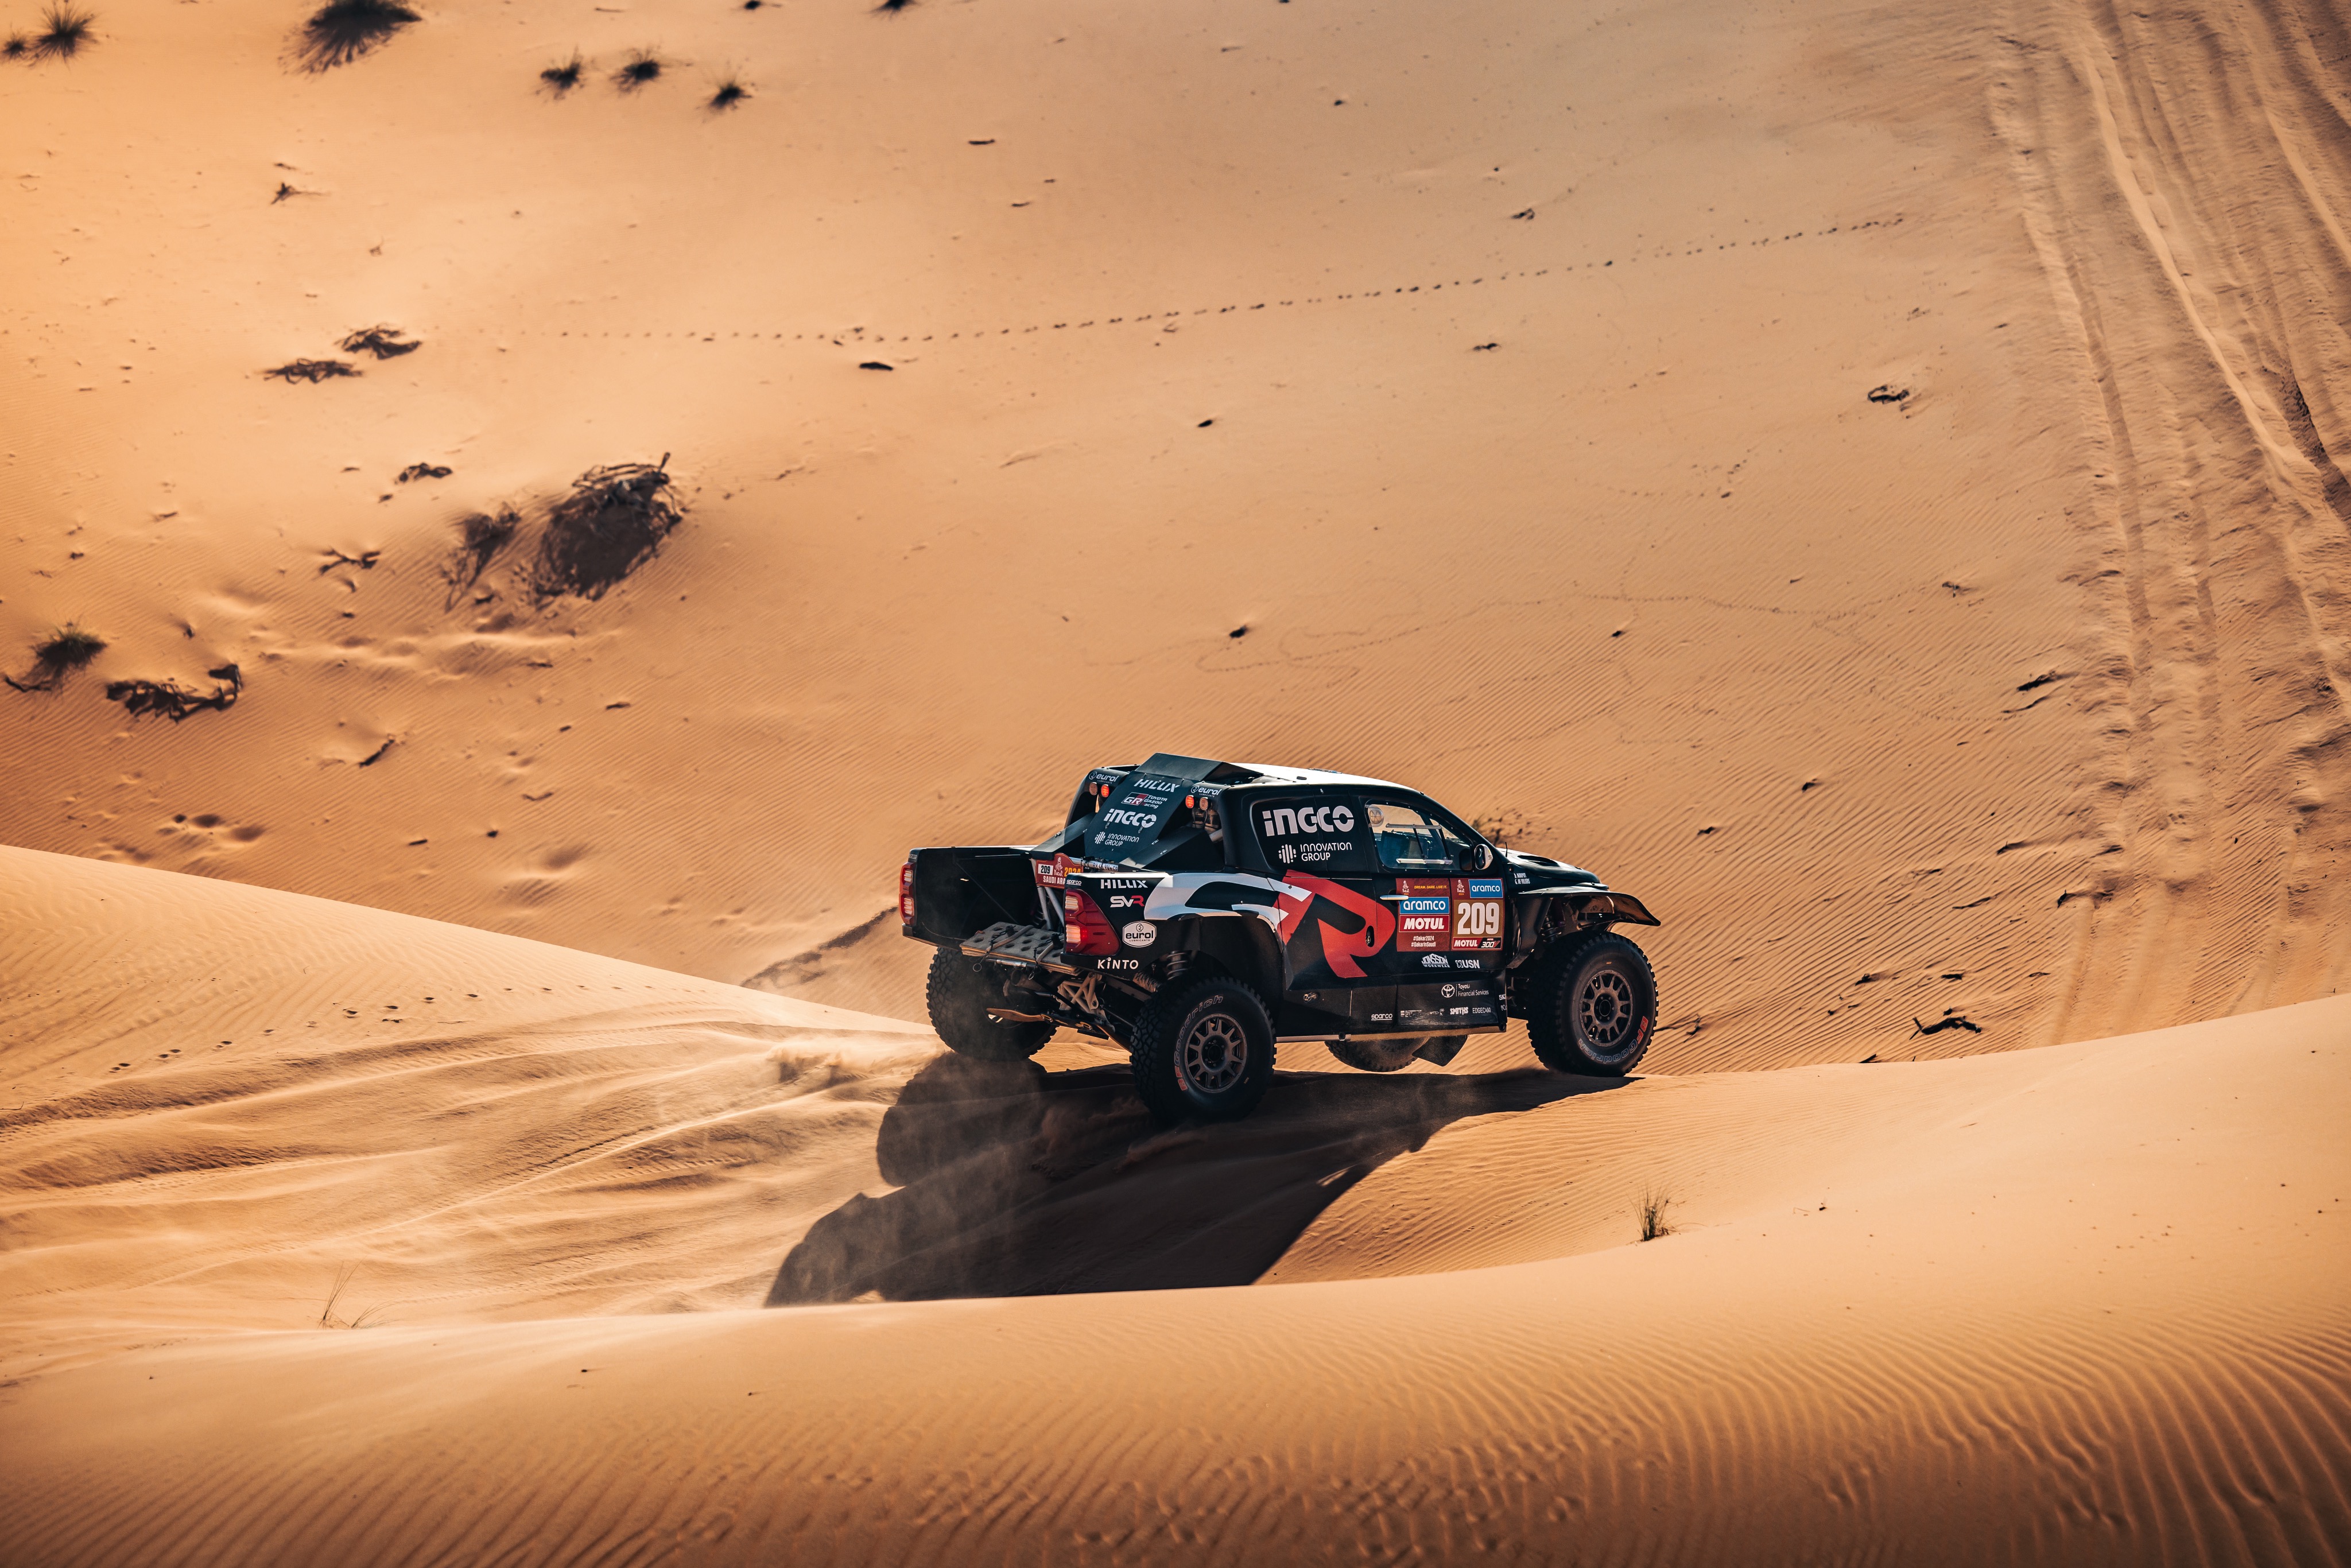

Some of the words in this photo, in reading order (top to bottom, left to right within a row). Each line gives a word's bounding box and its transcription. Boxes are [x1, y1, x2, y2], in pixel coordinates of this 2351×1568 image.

[1096, 773, 1120, 782] eurol
[1134, 778, 1181, 793] HILUX
[1198, 787, 1223, 795] eurol
[1123, 797, 1143, 805] GR
[1108, 833, 1140, 843] INNOVATION
[1300, 842, 1352, 852] INNOVATION
[1301, 852, 1330, 861] GROUP
[1041, 865, 1050, 874] 209
[1043, 875, 1056, 884] SAUDI
[1057, 877, 1066, 885] ARA
[1100, 879, 1149, 889] HILUX
[1110, 895, 1145, 908] SVR
[1403, 901, 1446, 910] aramco
[1457, 902, 1500, 935] 209
[1403, 918, 1445, 930] MOTUL
[1126, 930, 1154, 939] eurol
[1421, 953, 1448, 964] JONSSON
[1462, 960, 1480, 969] USN
[1174, 995, 1224, 1091] BFGoodrich
[1578, 1016, 1648, 1064] BFGoodrich
